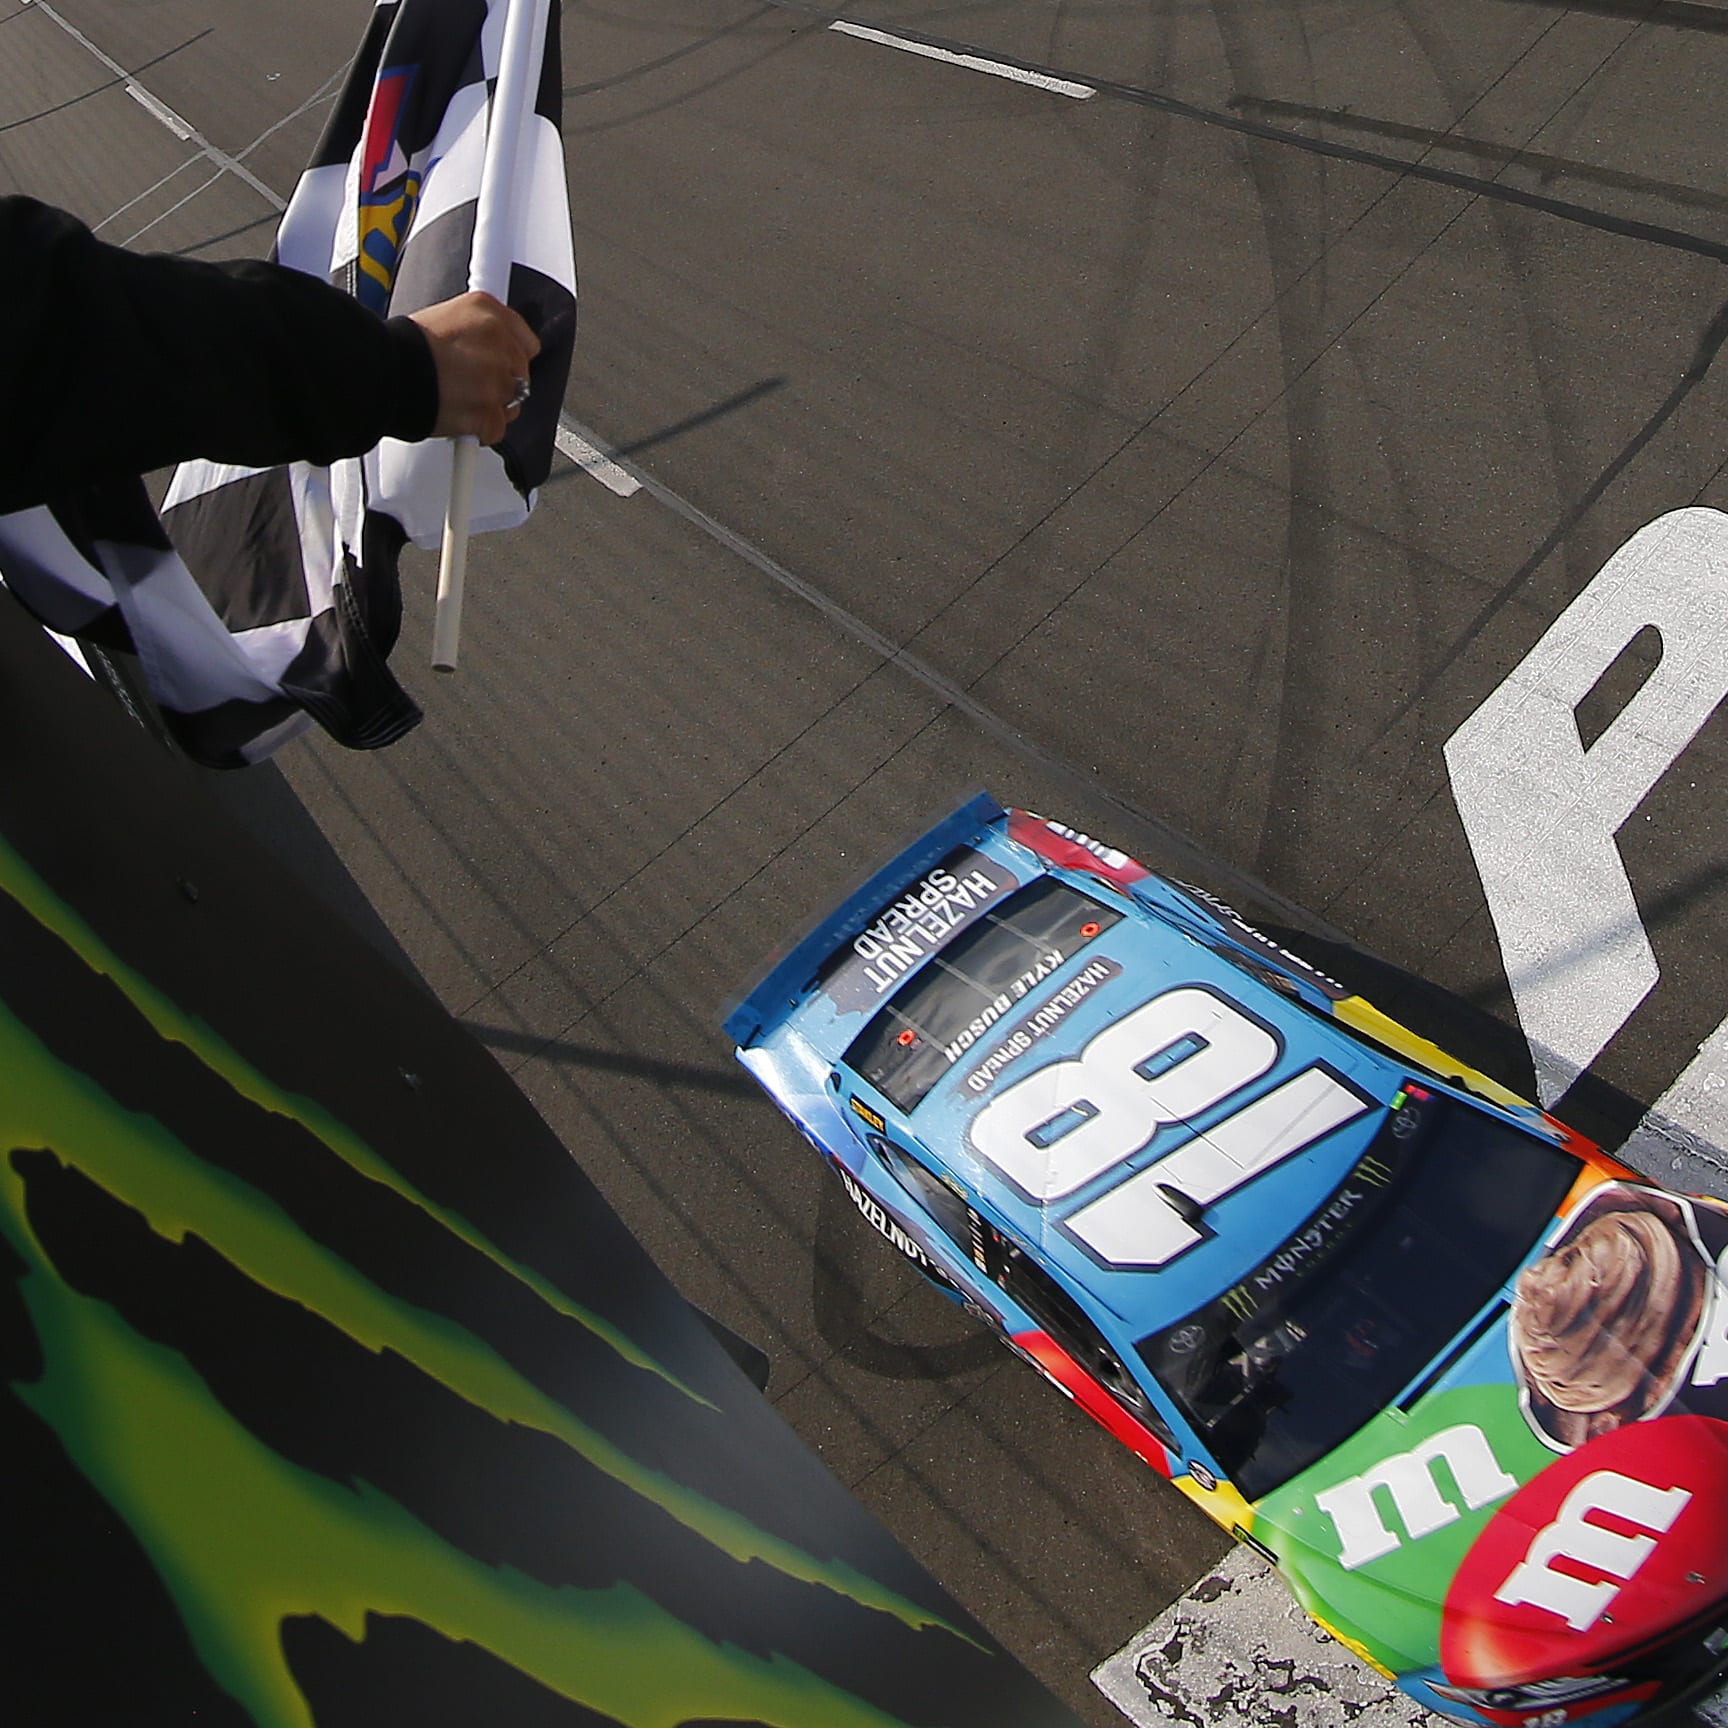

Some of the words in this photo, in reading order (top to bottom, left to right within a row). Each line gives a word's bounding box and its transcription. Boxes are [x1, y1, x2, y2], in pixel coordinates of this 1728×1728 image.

[852, 868, 961, 962] SPREAD
[863, 869, 999, 994] HAZELNUT
[1009, 949, 1066, 1000] KYLE
[1026, 961, 1111, 1037] HAZELNUT
[943, 992, 1016, 1065] BUSCH
[967, 1028, 1033, 1092] SPREAD
[968, 987, 1372, 1274] 18
[840, 1168, 929, 1267] HAZELNUT
[1253, 1187, 1364, 1291] MONSTER
[1313, 1422, 1520, 1572] m
[1492, 1469, 1693, 1634] m
